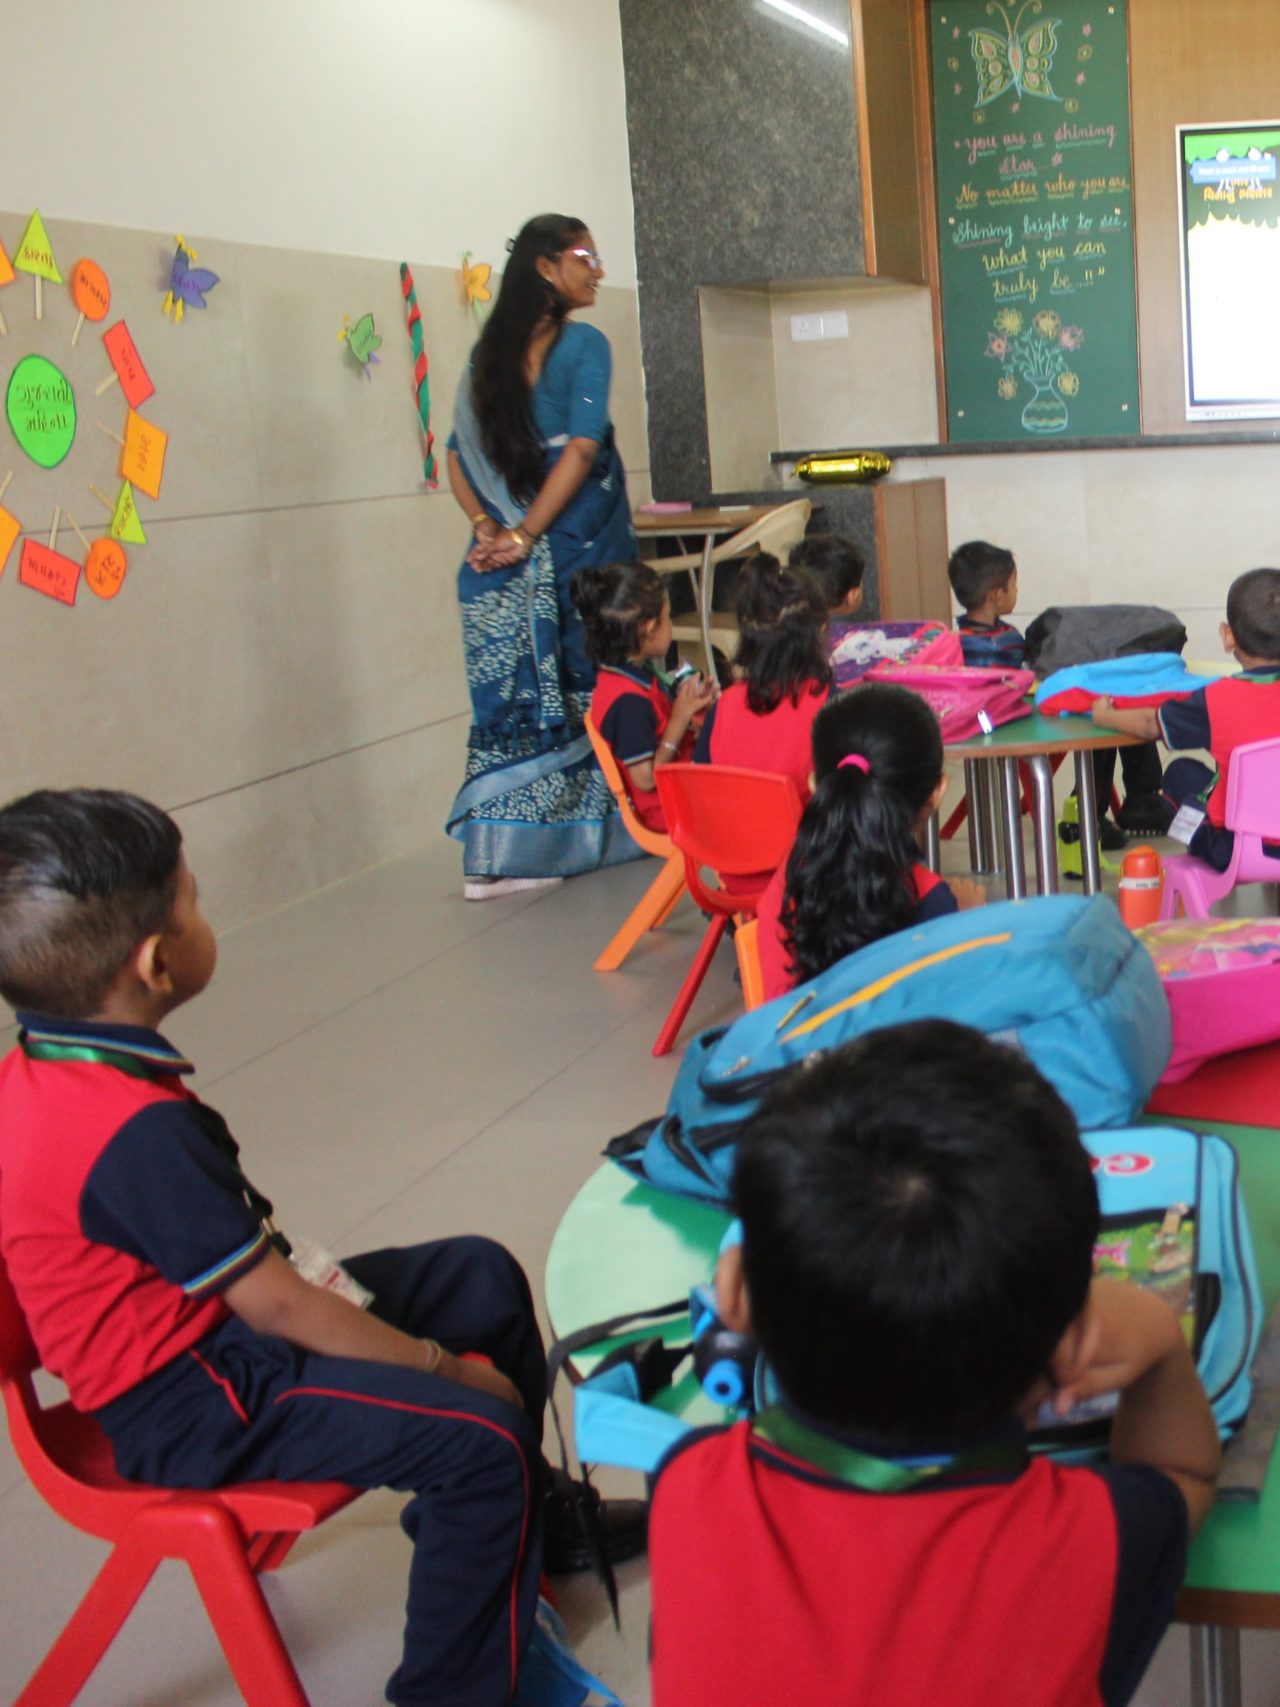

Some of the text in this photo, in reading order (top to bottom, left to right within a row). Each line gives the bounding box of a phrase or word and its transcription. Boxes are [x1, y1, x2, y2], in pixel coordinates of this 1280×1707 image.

[956, 182, 979, 203] No
[1044, 172, 1077, 193] who
[1076, 211, 1094, 231] to
[1036, 246, 1066, 272] you
[1073, 241, 1107, 257] can
[991, 270, 1039, 303] truly
